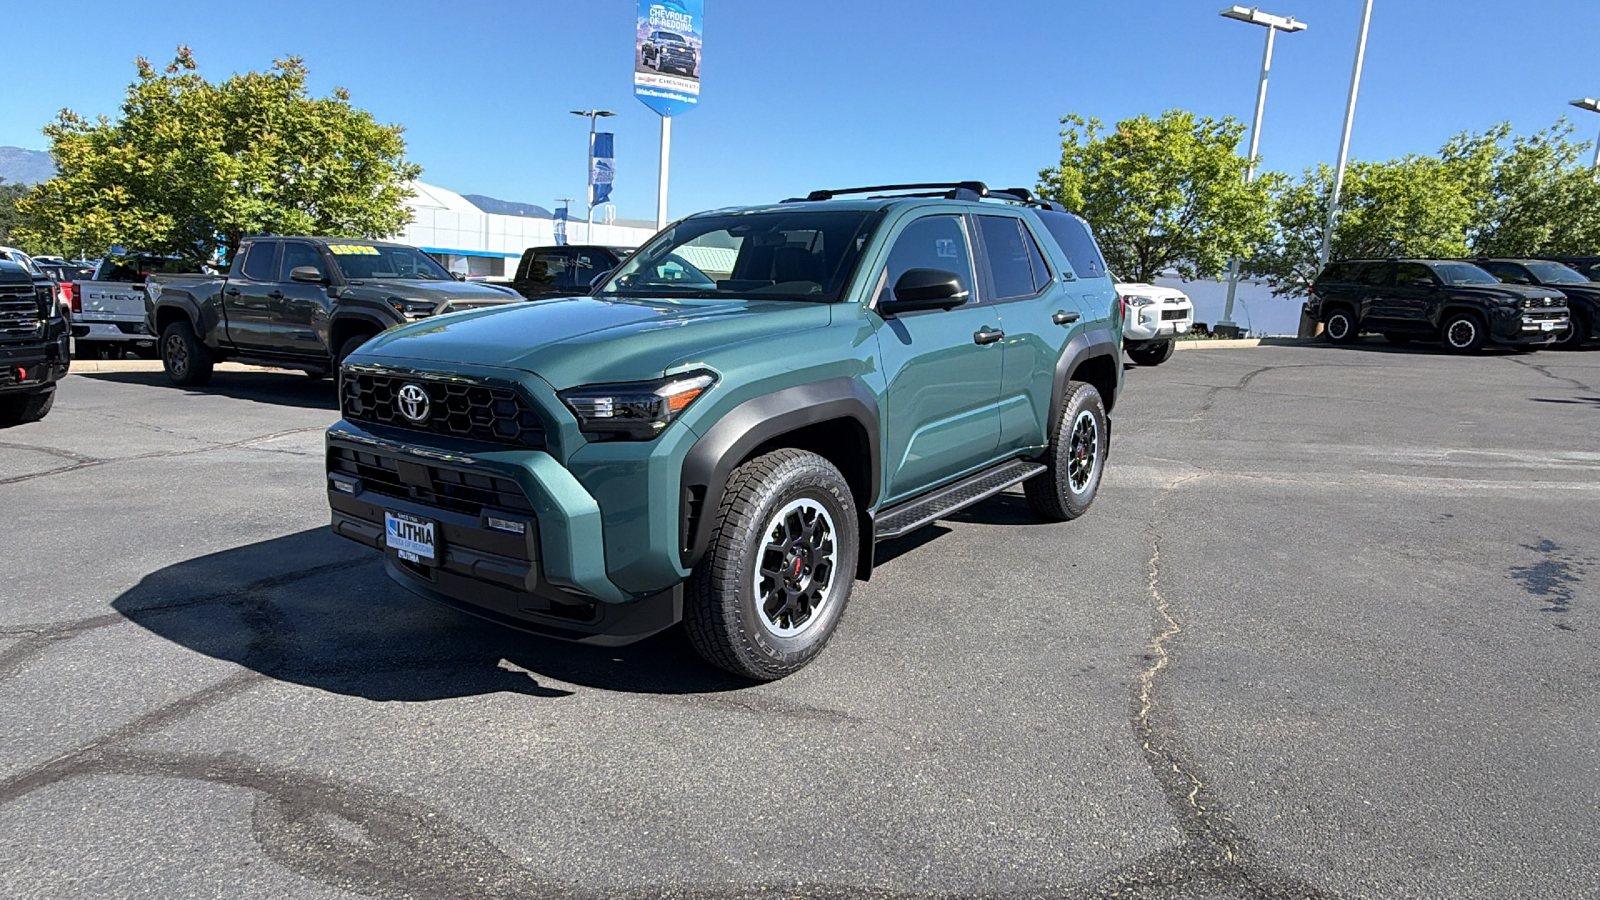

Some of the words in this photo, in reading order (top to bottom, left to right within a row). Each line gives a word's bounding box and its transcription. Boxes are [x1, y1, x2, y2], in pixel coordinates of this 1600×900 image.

[650, 8, 693, 24] CHEVROLET
[650, 16, 660, 26] OF
[661, 18, 693, 32] REDDING
[90, 293, 146, 301] CHEVR
[397, 520, 435, 547] LITHIA
